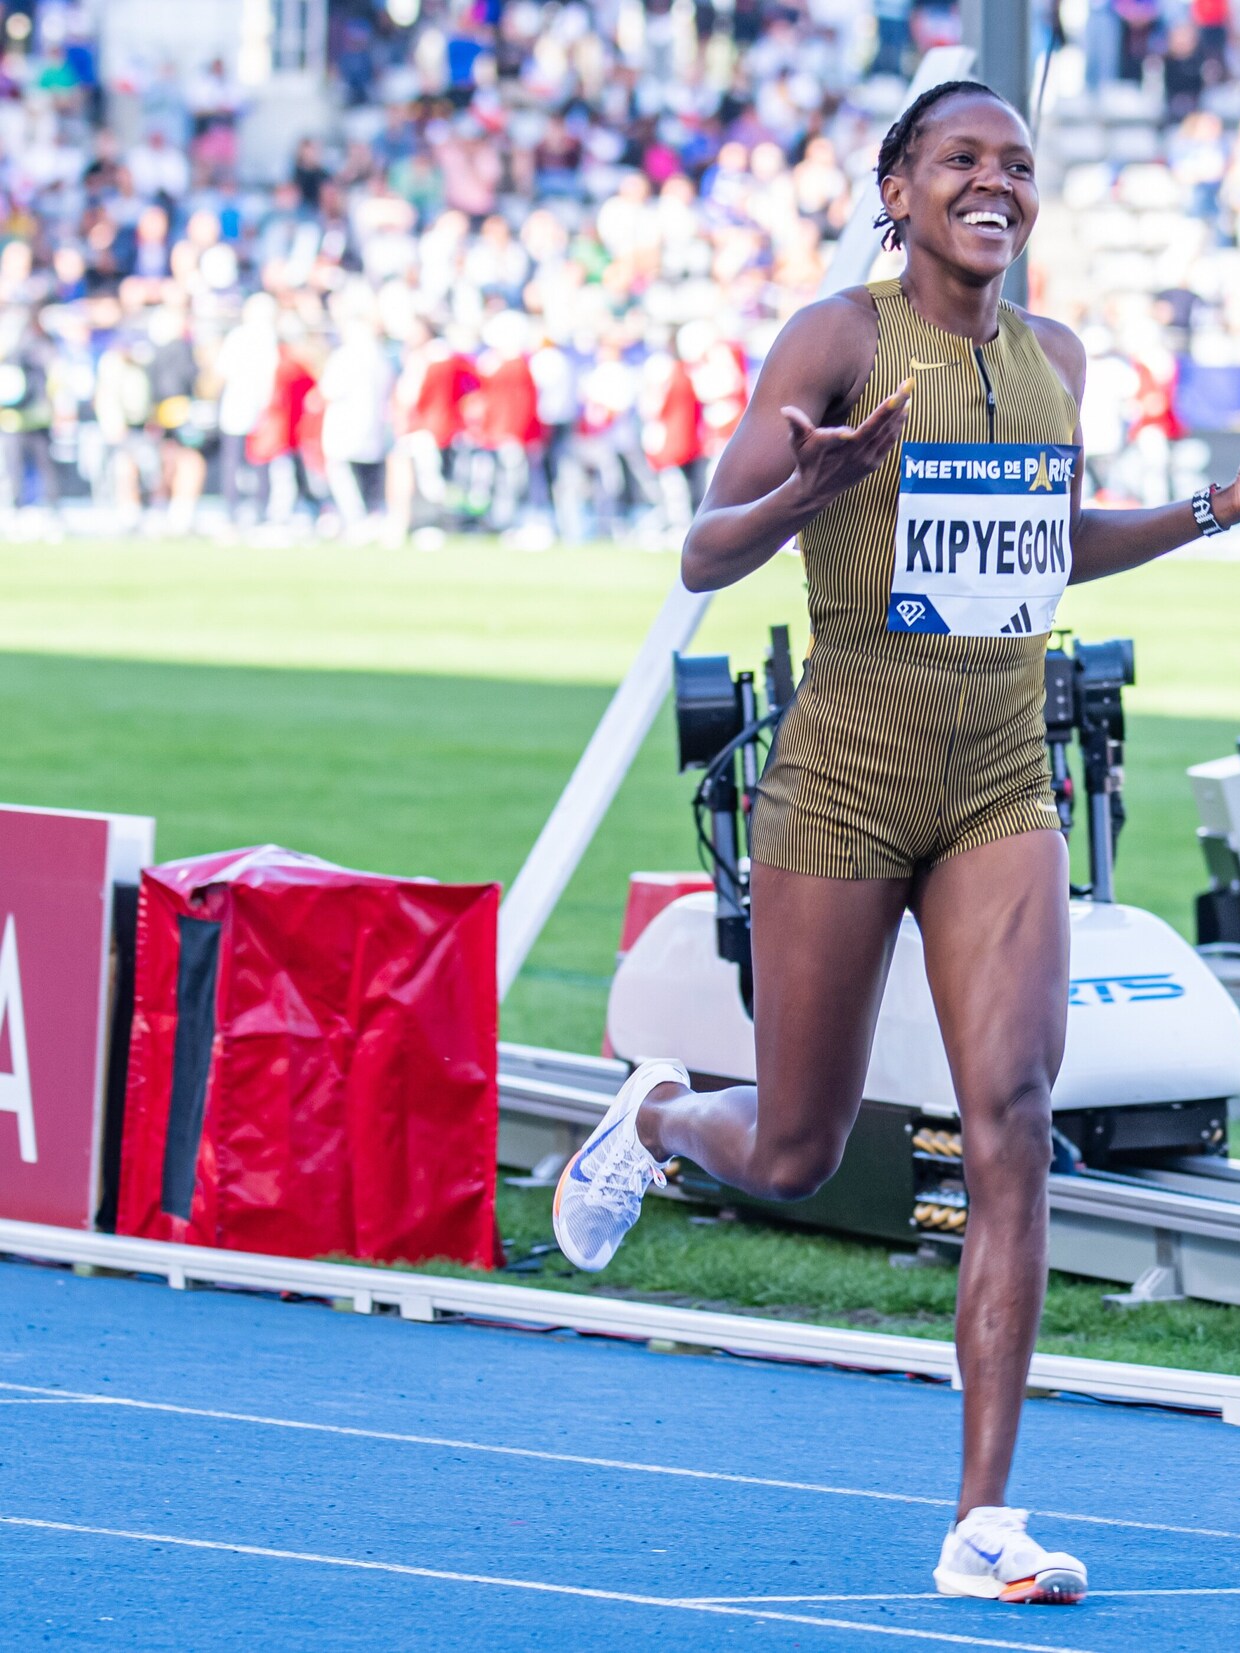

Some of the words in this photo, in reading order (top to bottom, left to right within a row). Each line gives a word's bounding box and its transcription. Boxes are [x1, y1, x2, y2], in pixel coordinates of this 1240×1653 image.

[905, 459, 1000, 479] MEETING
[1004, 460, 1021, 479] DE
[906, 519, 1066, 574] KIPYEGON
